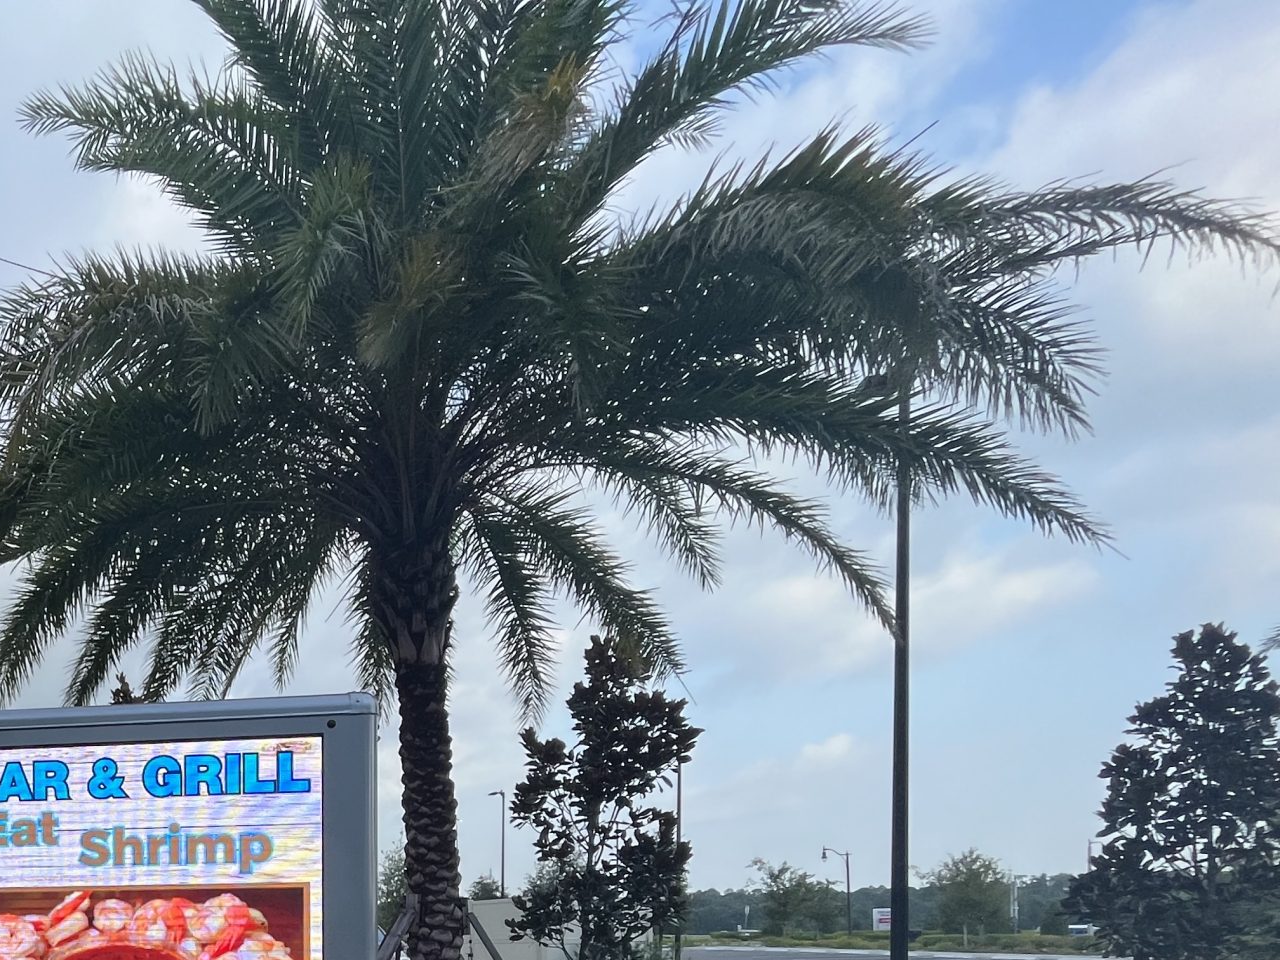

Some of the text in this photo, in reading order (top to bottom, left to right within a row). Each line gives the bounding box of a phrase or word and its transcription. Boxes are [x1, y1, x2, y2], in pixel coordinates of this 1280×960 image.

[87, 757, 131, 799] &
[142, 750, 312, 797] GRILL
[78, 821, 274, 874] Shrimp
